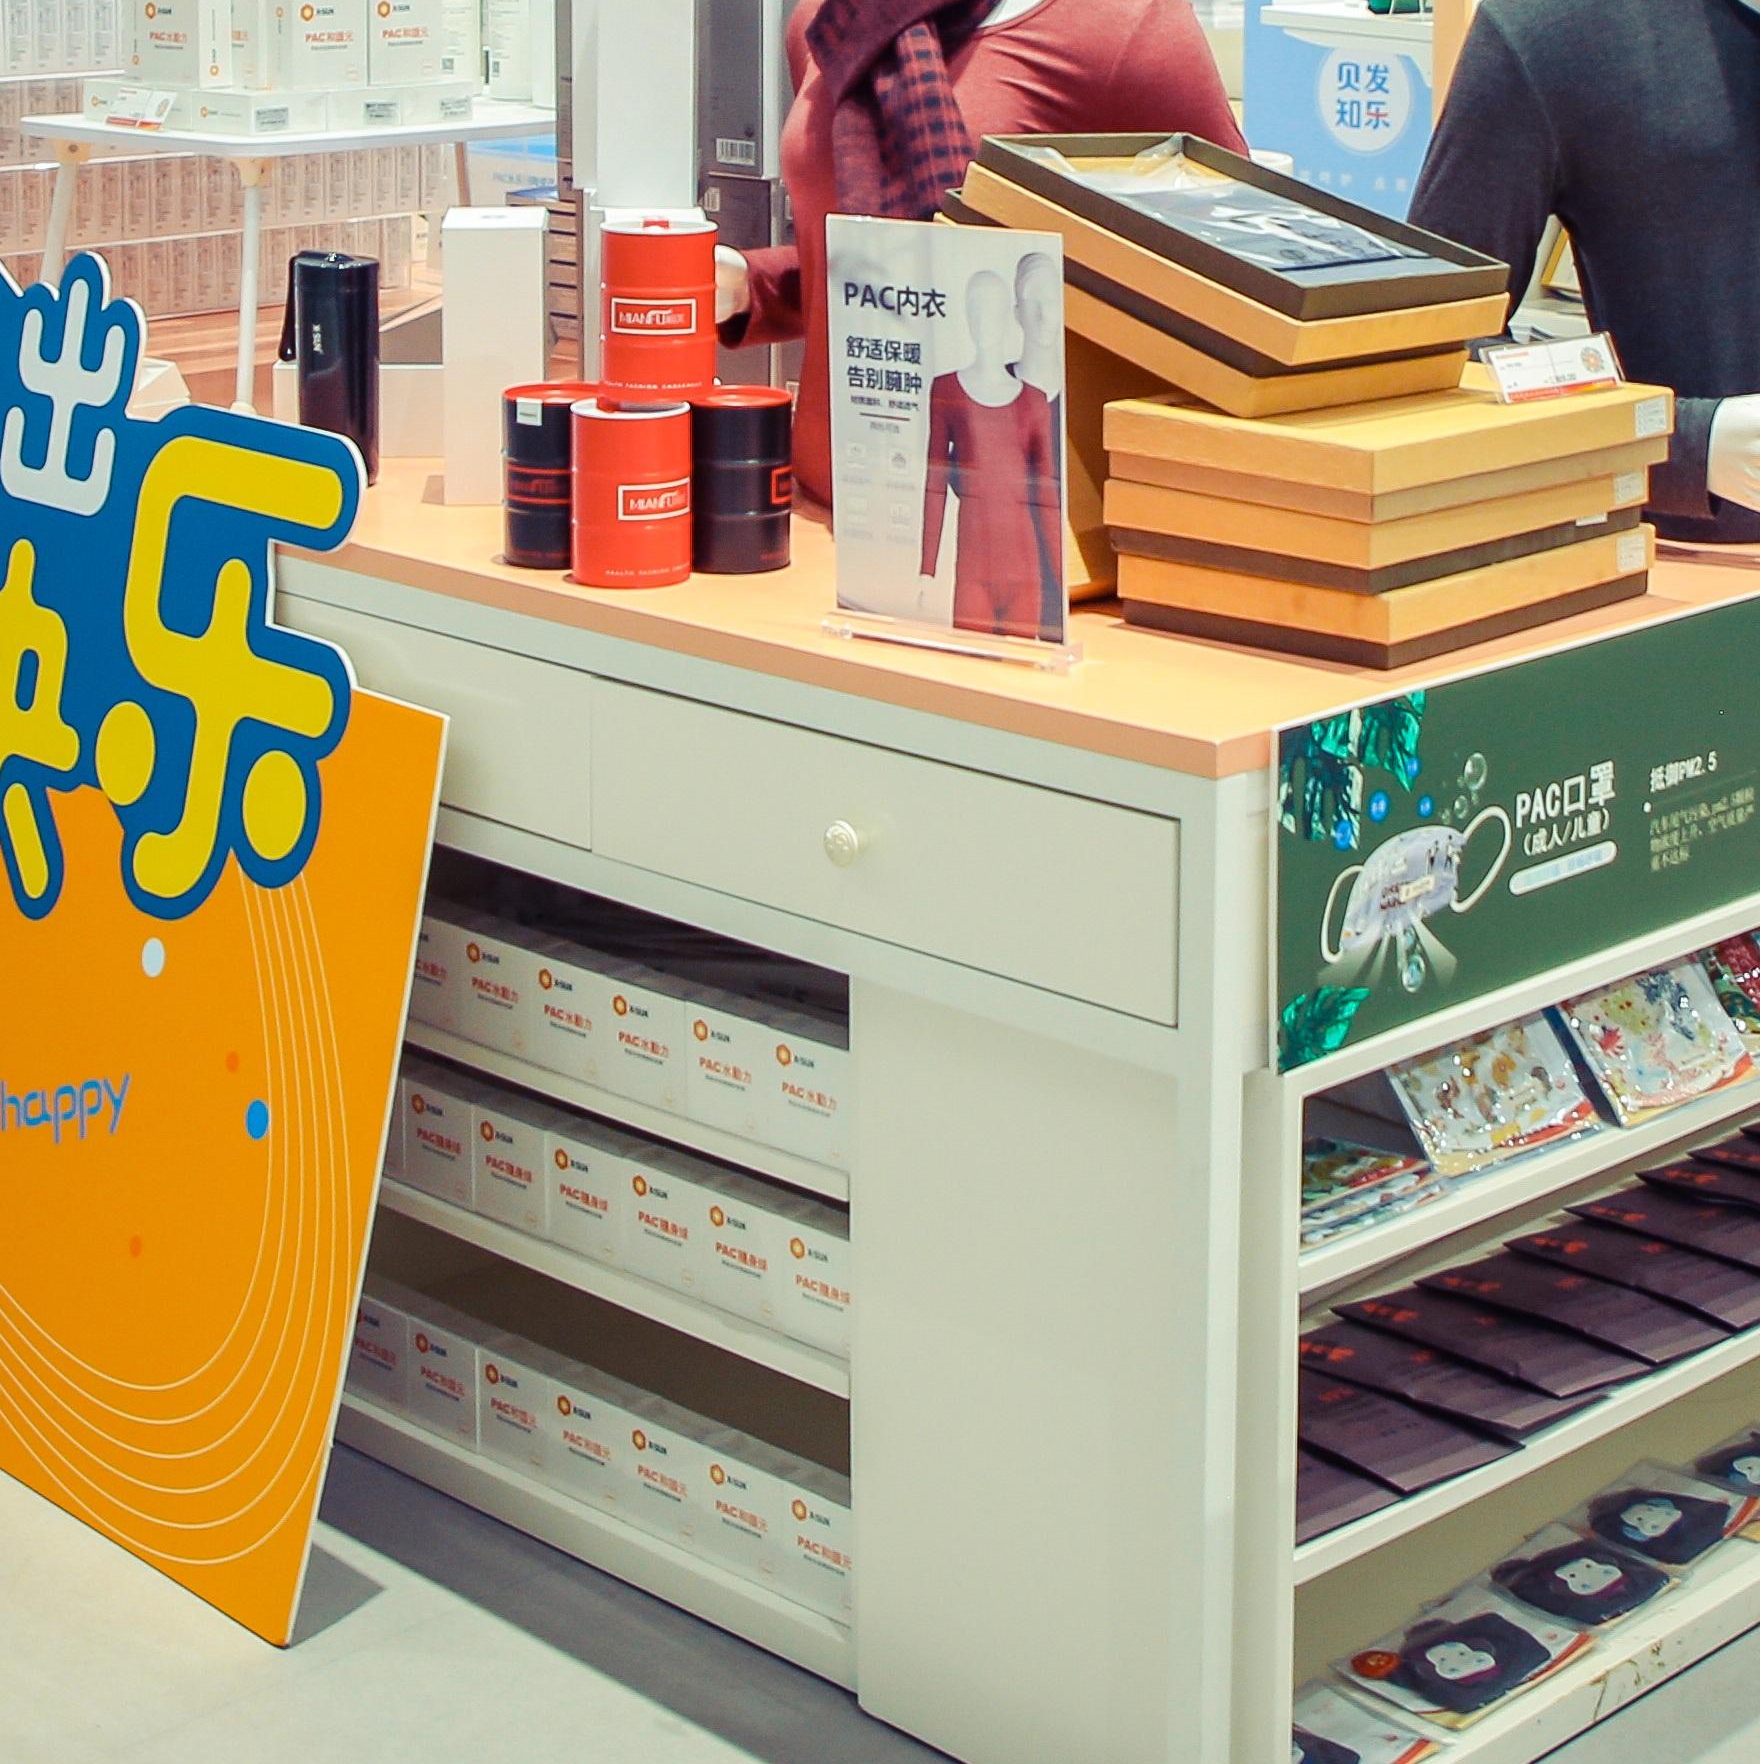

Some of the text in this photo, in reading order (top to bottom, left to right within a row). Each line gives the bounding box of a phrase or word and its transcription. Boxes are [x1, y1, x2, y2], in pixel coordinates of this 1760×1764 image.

[1337, 62, 1391, 95] 贝发
[843, 281, 947, 319] PAC内衣
[846, 335, 922, 365] 舒适保暖
[846, 365, 923, 395] 告别臃肿
[1515, 759, 1617, 829] PAC口罩
